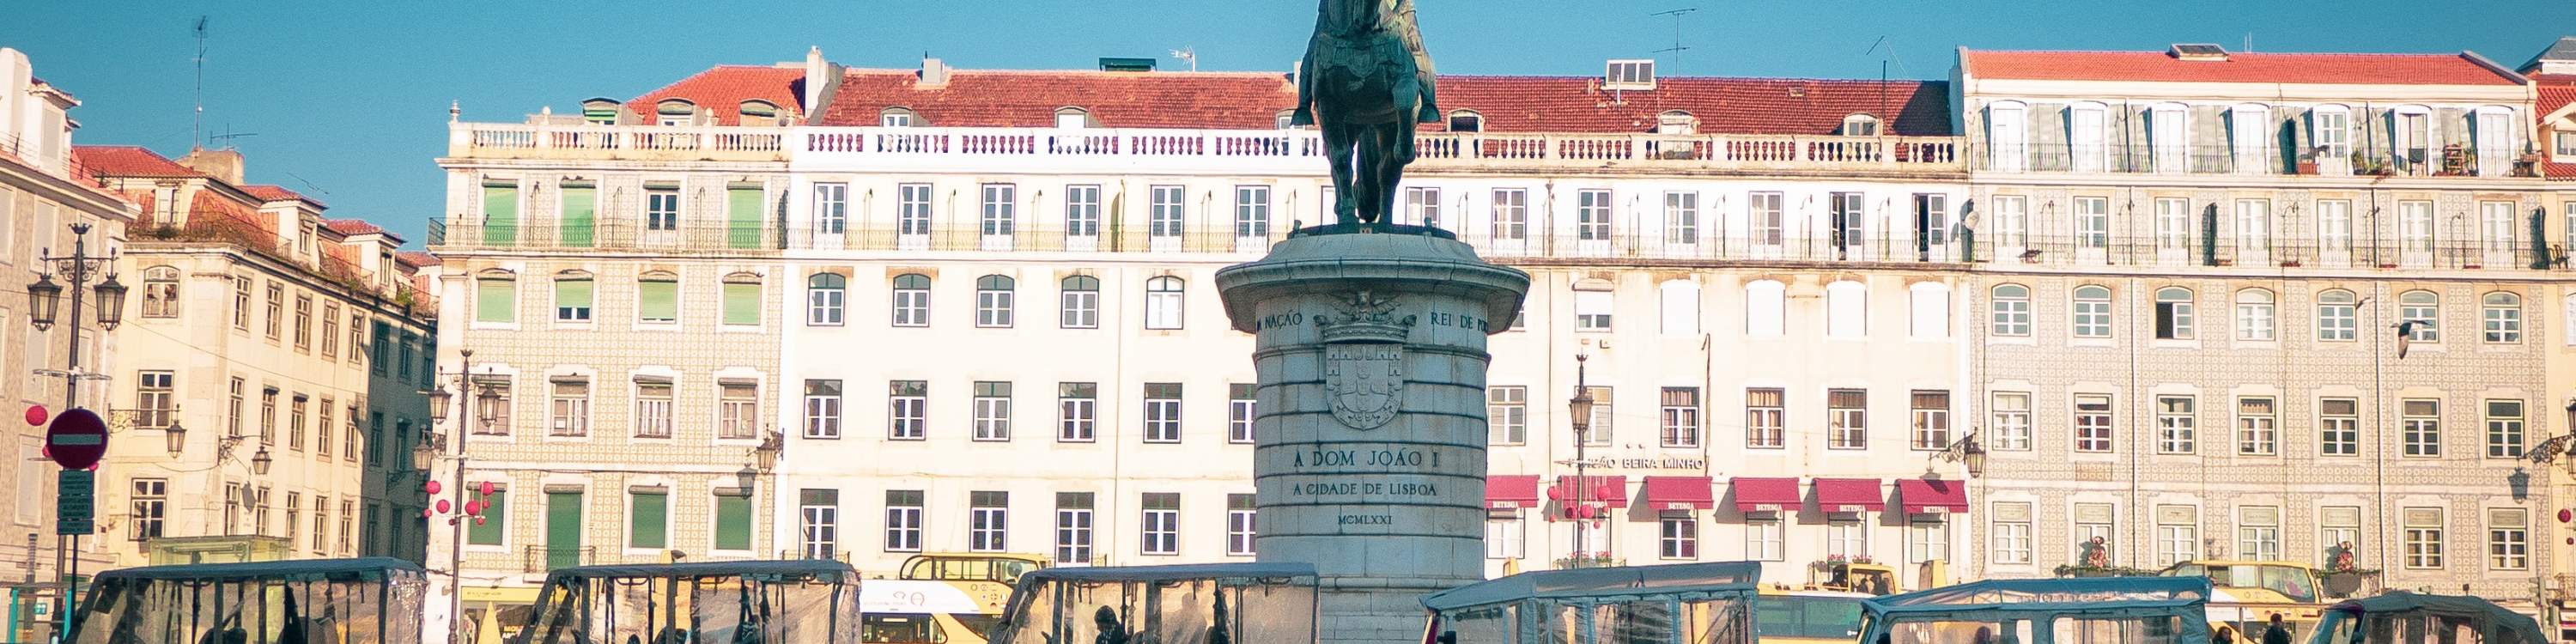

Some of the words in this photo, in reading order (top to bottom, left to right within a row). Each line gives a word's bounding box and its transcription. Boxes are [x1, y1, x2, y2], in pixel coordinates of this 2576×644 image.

[1265, 310, 1303, 330] NAÇÃO
[1431, 312, 1452, 326] REI
[1460, 314, 1473, 329] DE
[1294, 451, 1304, 467] A
[1313, 450, 1356, 466] DOM
[1367, 447, 1422, 466] JOÃO
[1432, 452, 1440, 467] I
[1622, 458, 1658, 470] BEIRA
[1662, 458, 1704, 470] MINHO
[1293, 483, 1302, 495] A
[1306, 483, 1358, 495] CIDADE
[1364, 483, 1382, 495] DE
[1389, 483, 1437, 495] LISBOA
[1338, 515, 1392, 525] MCMLXXI
